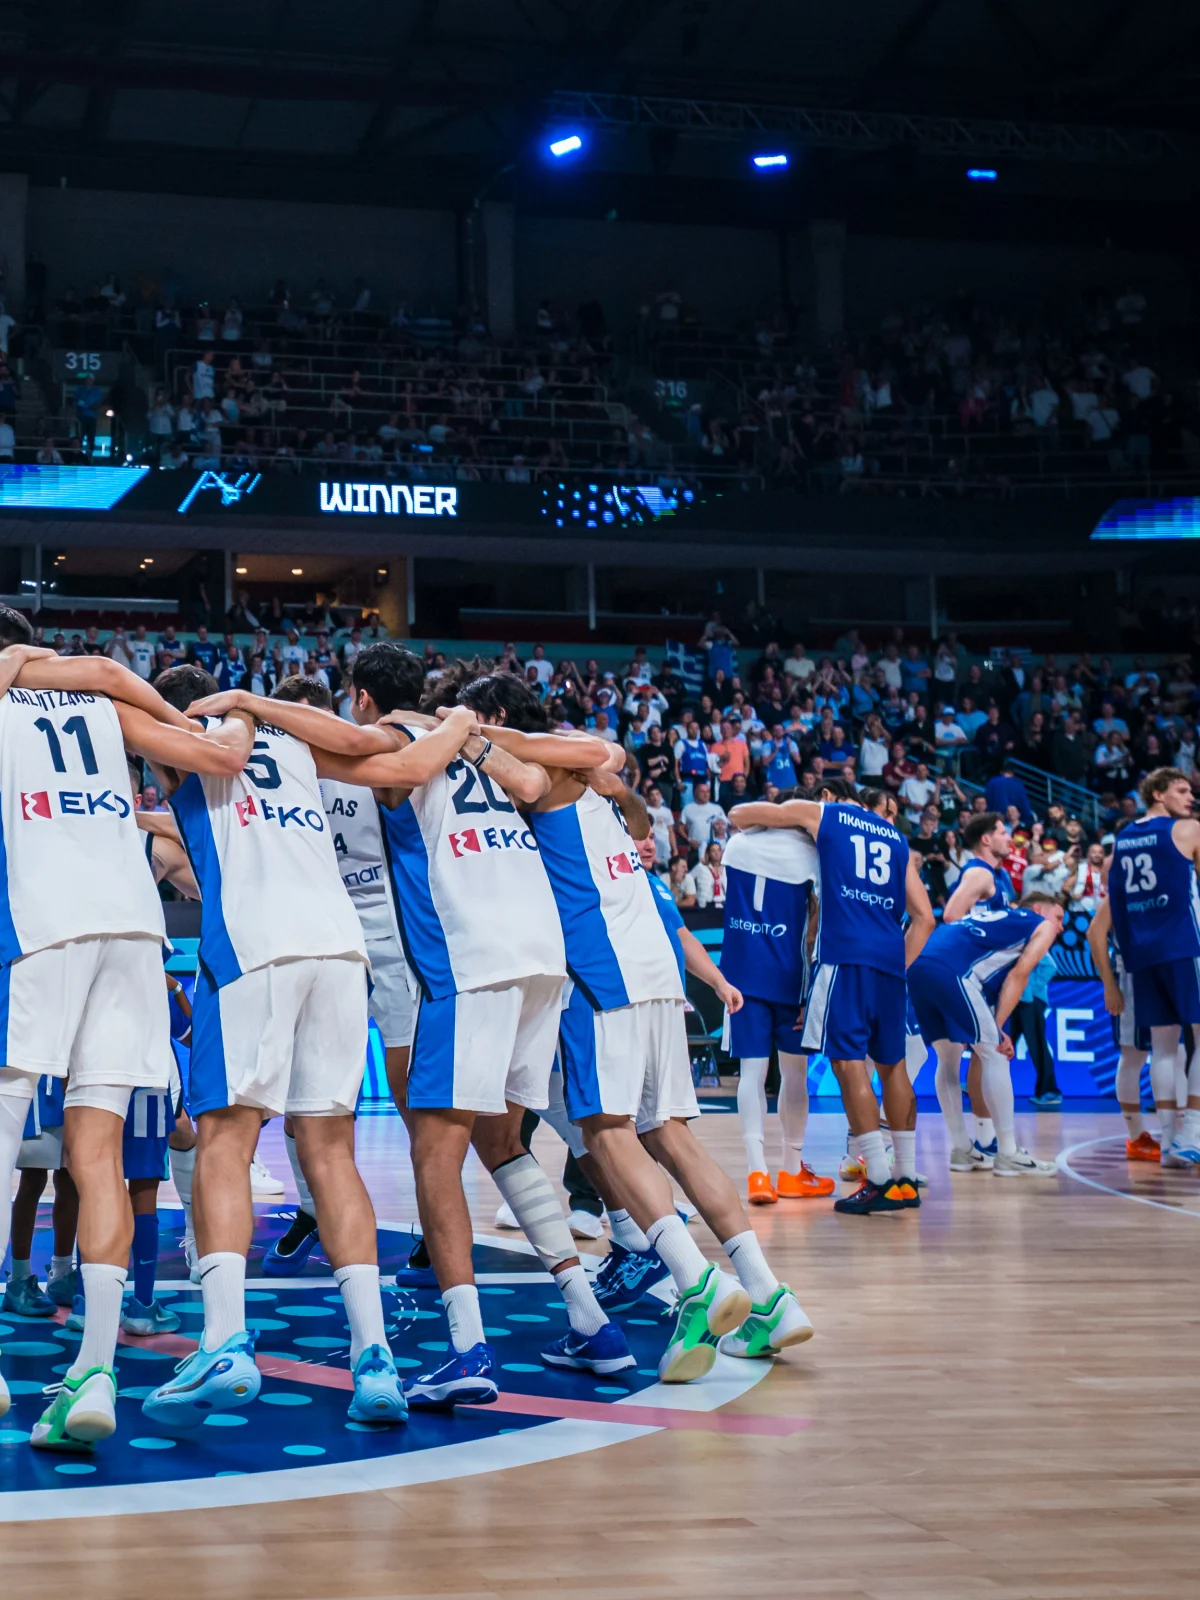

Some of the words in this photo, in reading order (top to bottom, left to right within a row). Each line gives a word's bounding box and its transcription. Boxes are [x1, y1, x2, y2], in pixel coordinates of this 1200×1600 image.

[65, 351, 102, 371] 315
[319, 481, 458, 517] WINNER
[33, 715, 100, 776] 11
[483, 827, 539, 851] EKO
[849, 834, 892, 886] 13
[1120, 852, 1158, 894] 23
